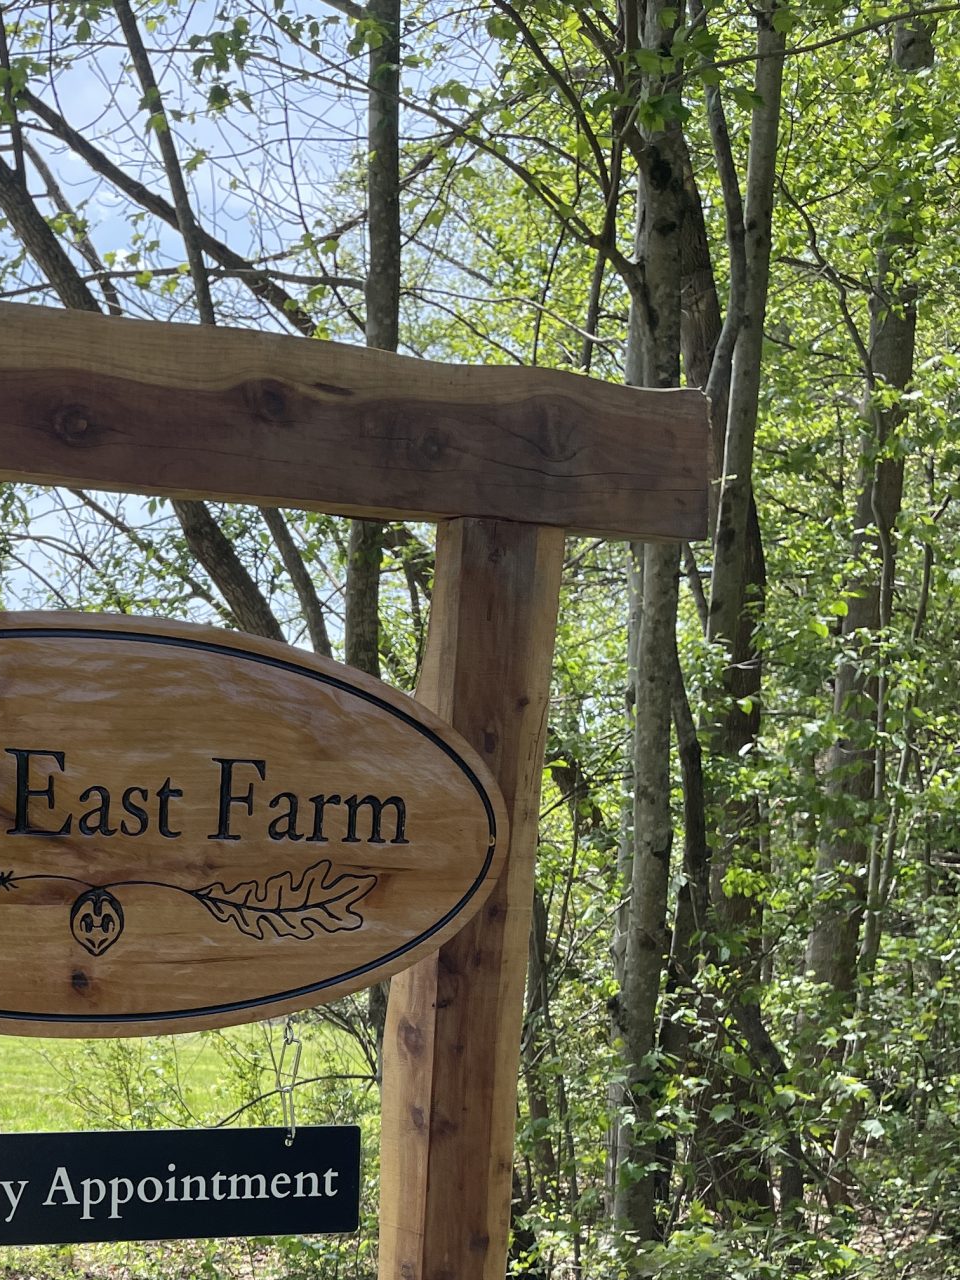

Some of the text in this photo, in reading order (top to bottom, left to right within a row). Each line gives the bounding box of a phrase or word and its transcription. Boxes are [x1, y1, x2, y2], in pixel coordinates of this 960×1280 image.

[6, 748, 182, 838] East
[208, 758, 410, 844] Farm
[43, 1163, 339, 1220] Appointment
